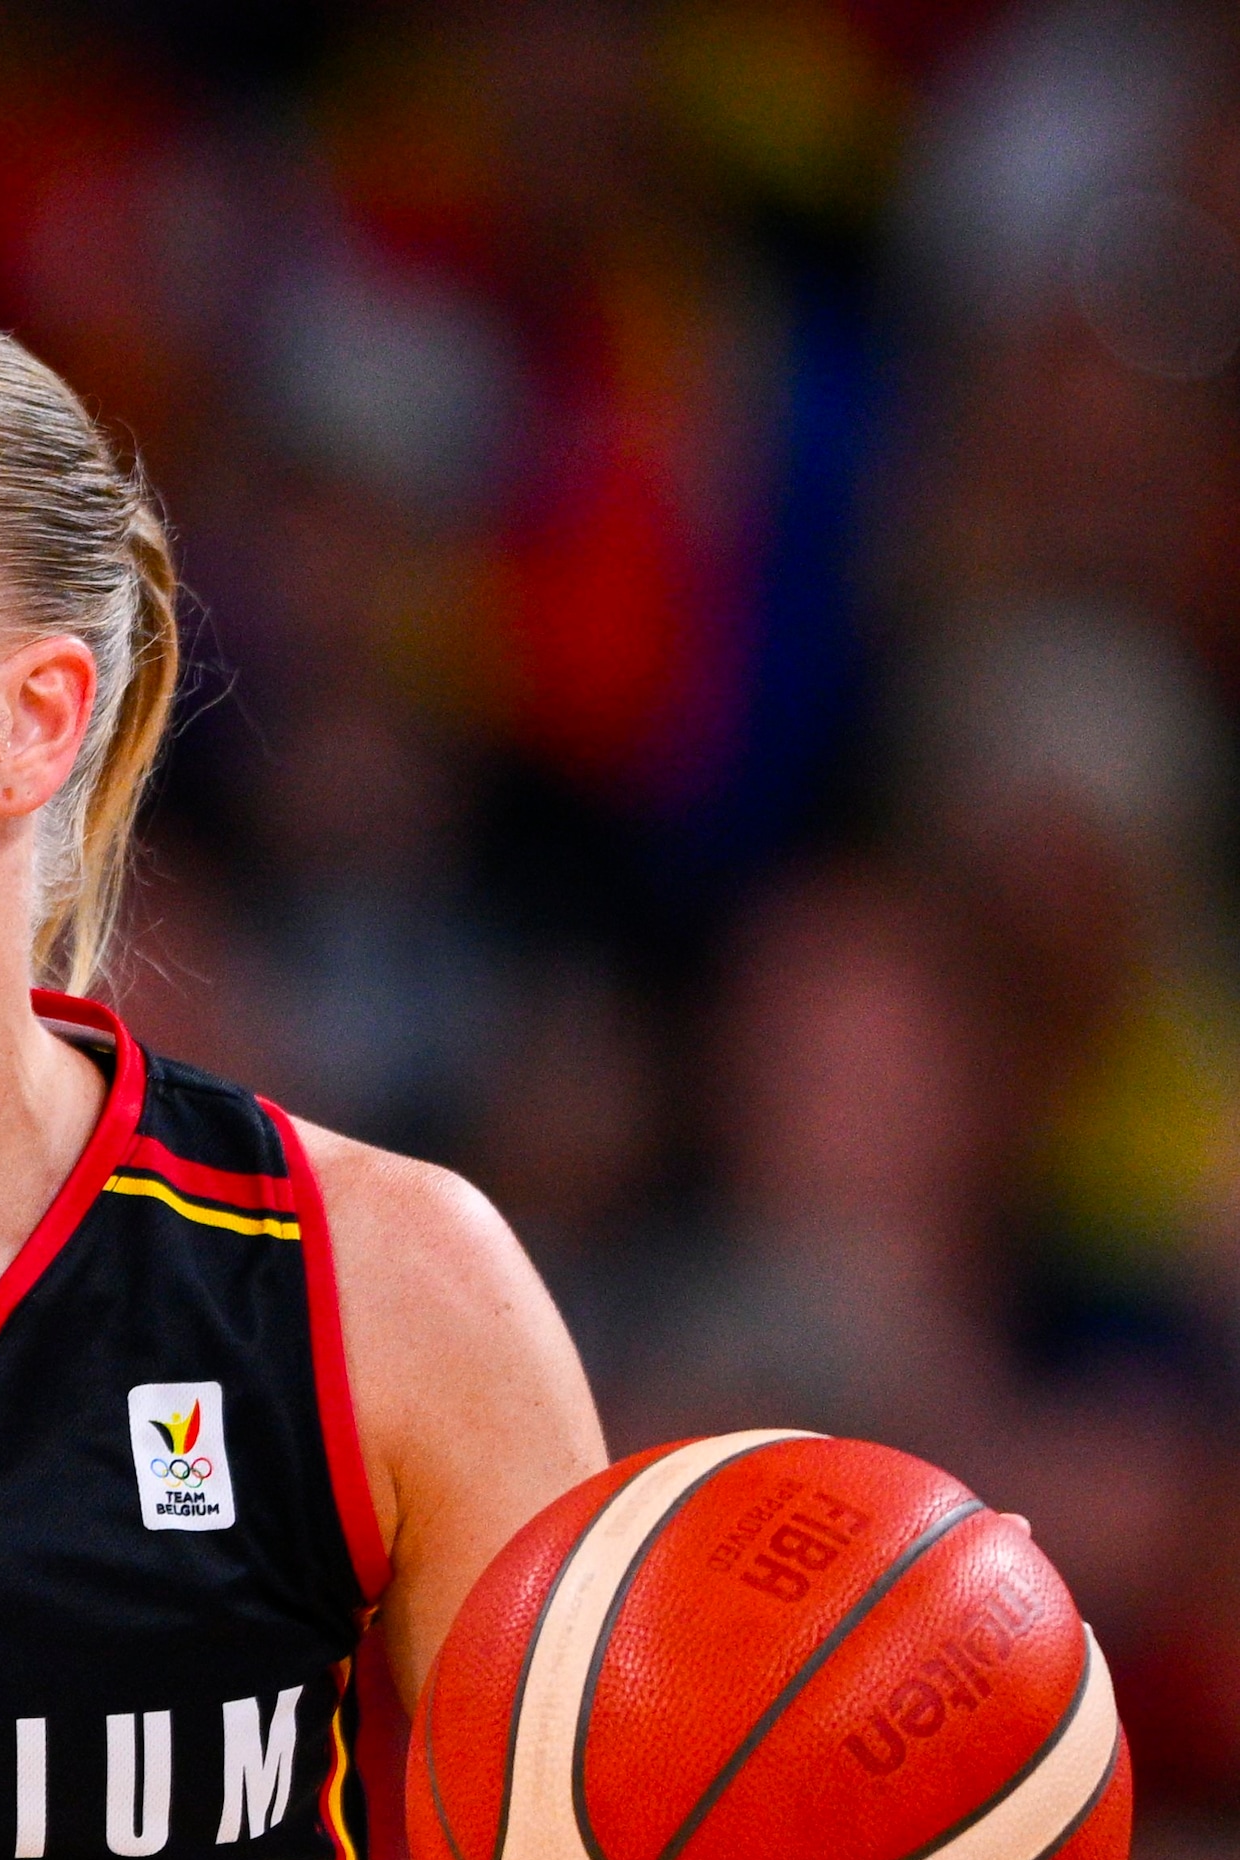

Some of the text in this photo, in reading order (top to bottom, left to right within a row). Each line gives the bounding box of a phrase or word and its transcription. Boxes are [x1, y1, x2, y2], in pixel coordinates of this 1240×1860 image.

[156, 1503, 220, 1516] BELGIUM
[165, 1491, 206, 1503] TEAM
[740, 1492, 871, 1602] FIBA
[839, 1571, 1046, 1776] molten
